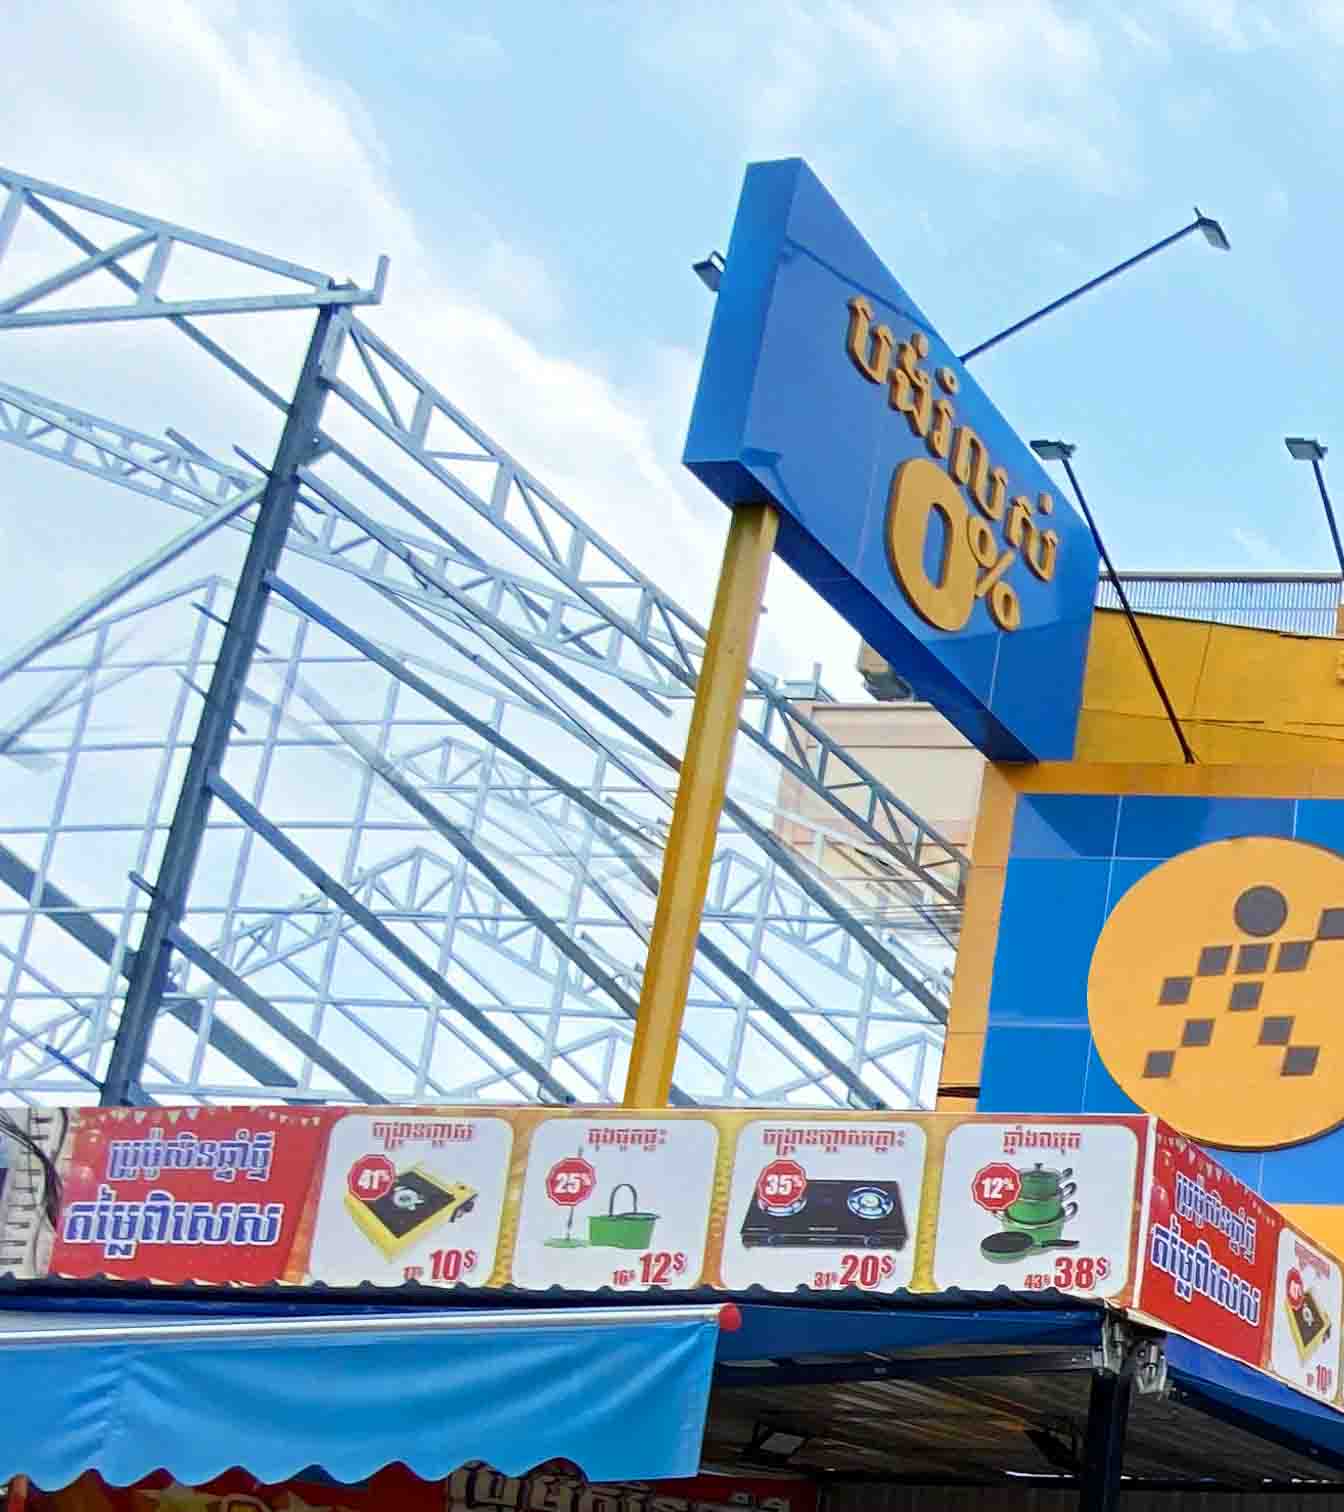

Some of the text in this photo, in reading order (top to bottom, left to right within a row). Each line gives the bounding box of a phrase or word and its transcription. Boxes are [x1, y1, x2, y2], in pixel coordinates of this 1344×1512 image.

[888, 457, 1022, 632] 0%
[432, 1248, 478, 1282] 10$
[640, 1251, 688, 1285] 12$
[840, 1252, 896, 1288] 20$
[1054, 1255, 1111, 1290] 38$
